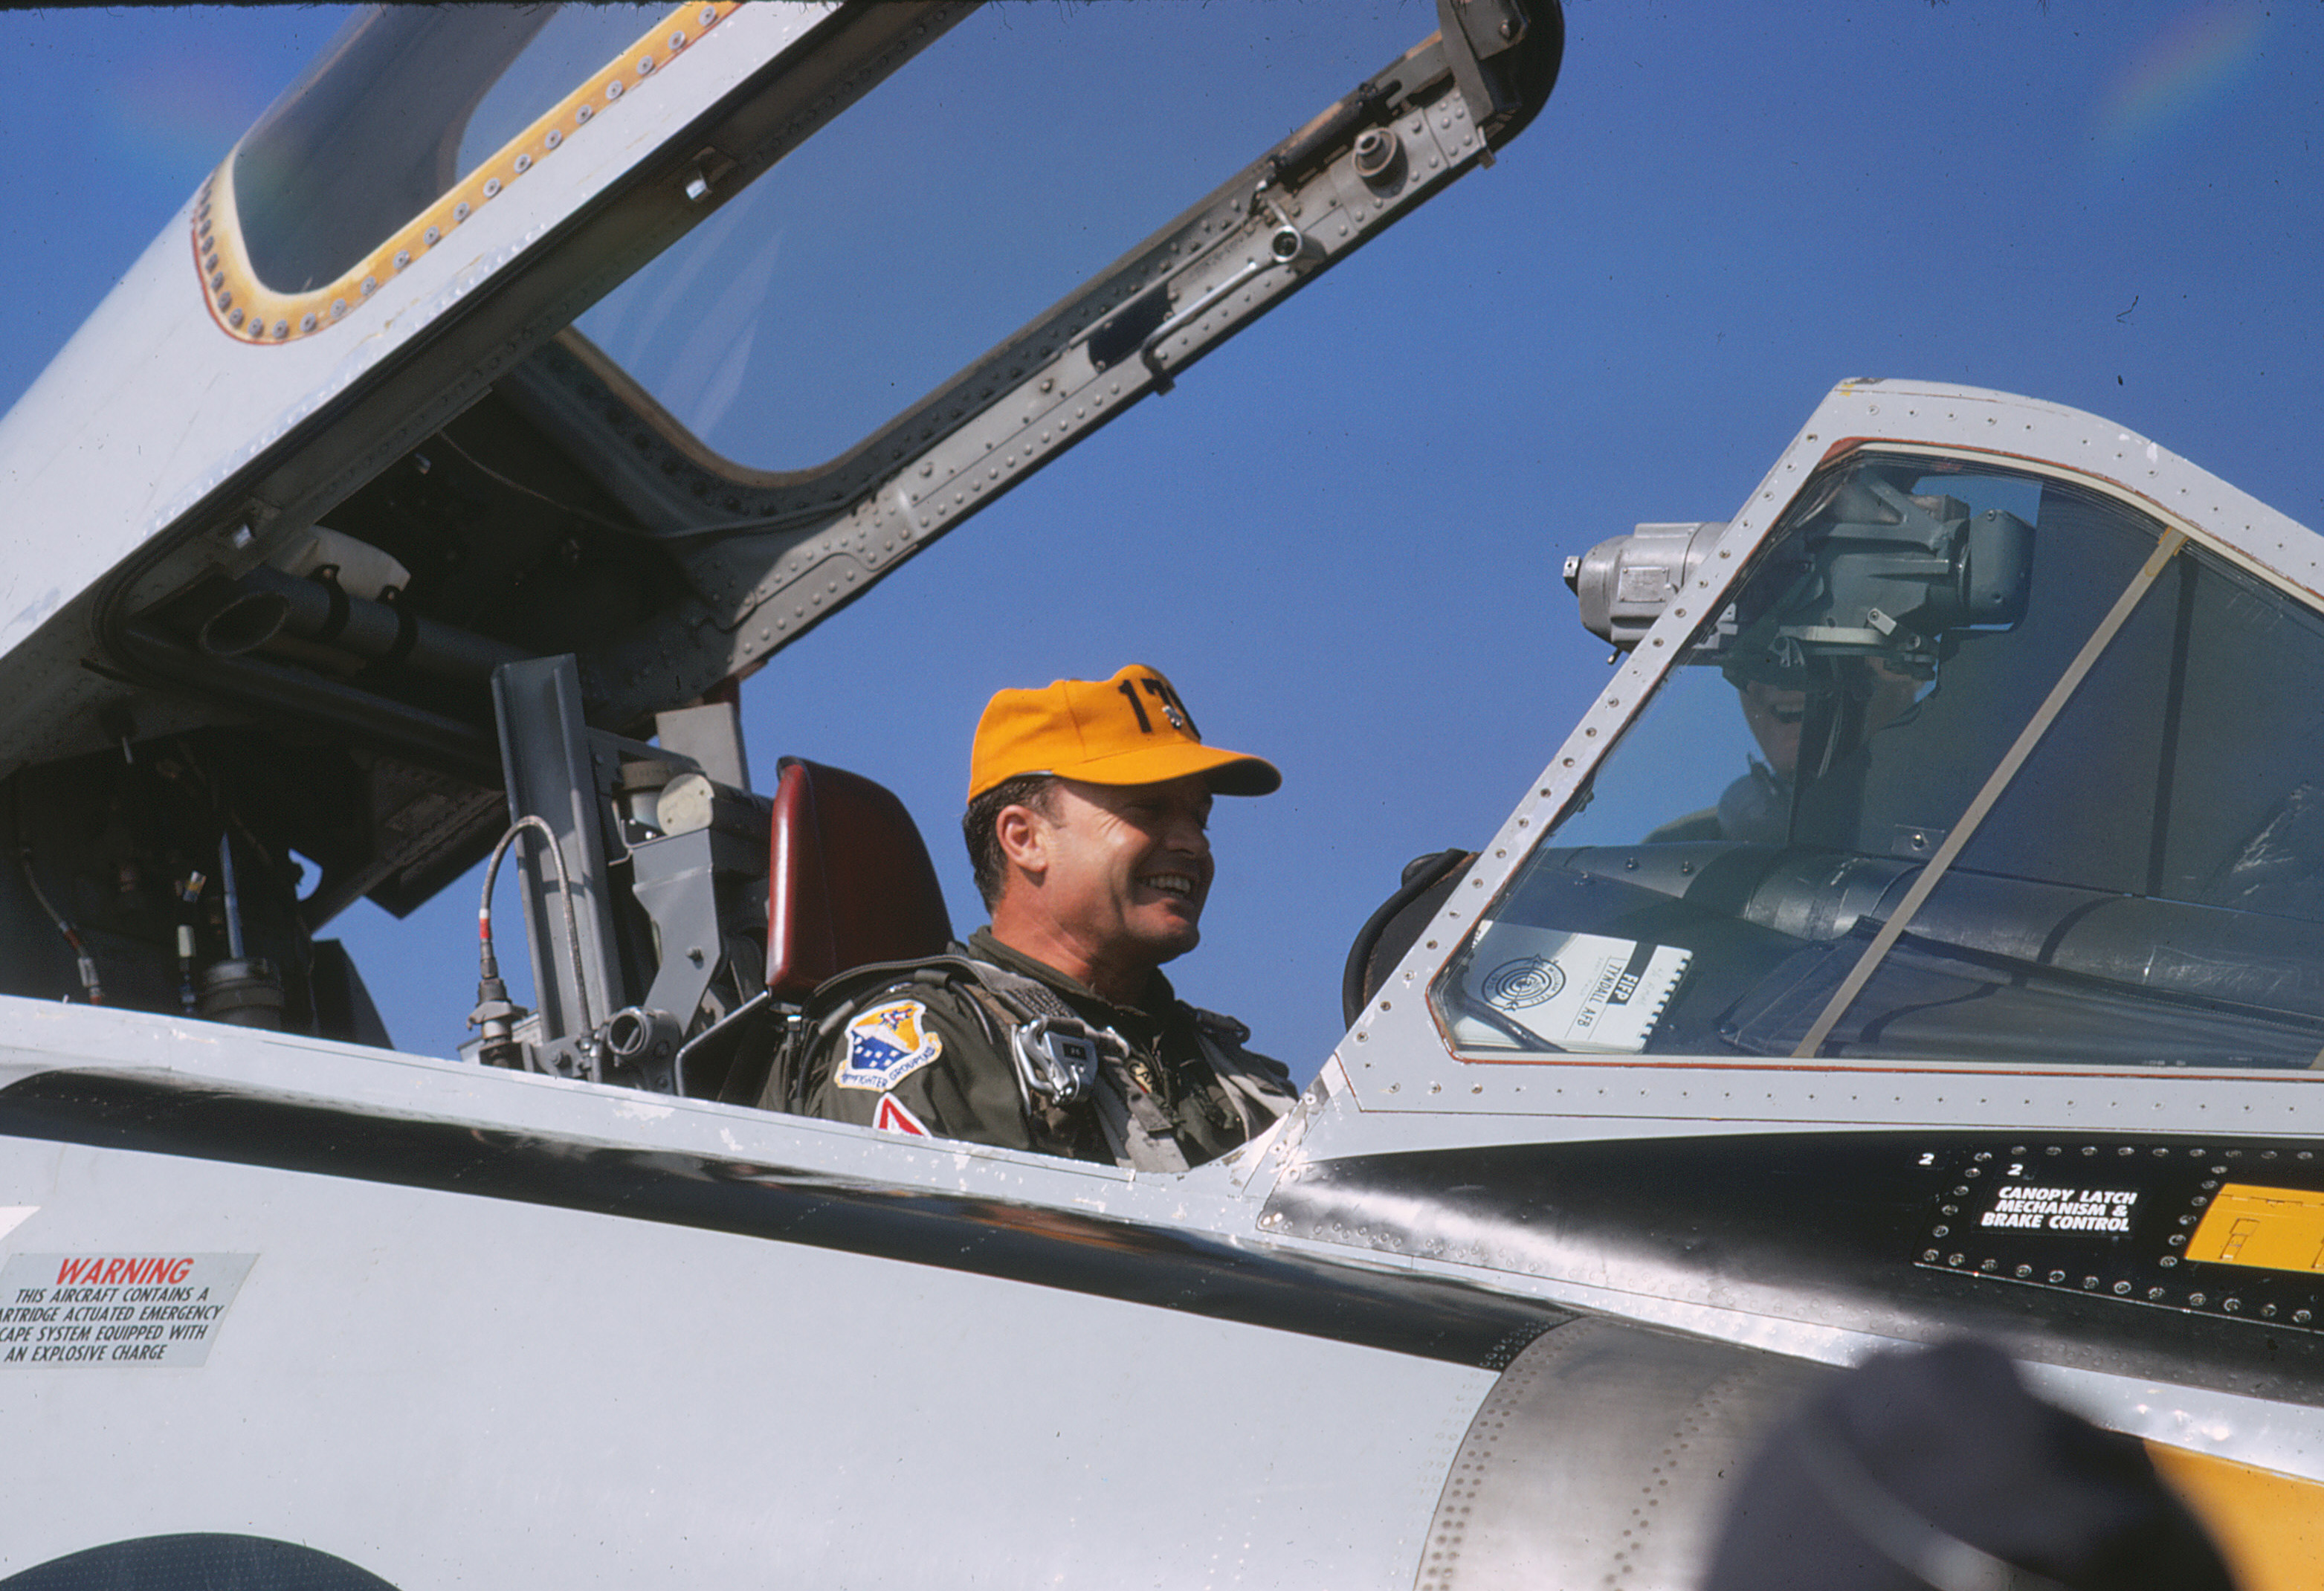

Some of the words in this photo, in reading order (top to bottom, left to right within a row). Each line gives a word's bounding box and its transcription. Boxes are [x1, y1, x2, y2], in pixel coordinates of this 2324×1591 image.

[1589, 964, 1622, 1004] TYNDALL
[1577, 1006, 1596, 1027] AFB
[1917, 1152, 1935, 1166] 2
[2007, 1163, 2024, 1176] 2
[1998, 1186, 2075, 1202] CANOPY
[2079, 1190, 2138, 1205] LATCH
[1994, 1199, 2107, 1216] MECHANISM
[2111, 1204, 2128, 1218] &
[1980, 1212, 2044, 1228] BRAKE
[2048, 1215, 2130, 1233] CONTROL
[56, 1257, 195, 1285] WARNING
[15, 1288, 47, 1303] THIS
[49, 1287, 120, 1303] AIRCRAFT
[122, 1286, 195, 1303] CONTAINS
[196, 1286, 210, 1302] A
[0, 1306, 60, 1323] RTRIDGE
[62, 1306, 135, 1322] ACTUATED
[138, 1305, 225, 1321] EMERGENCY
[36, 1325, 93, 1342] SYSTEM
[95, 1324, 164, 1342] EQUIPPED
[168, 1323, 209, 1340] WITH
[4, 1346, 29, 1363] AN
[31, 1344, 109, 1362] EXPLOSIVE
[112, 1343, 168, 1361] CHARGE
